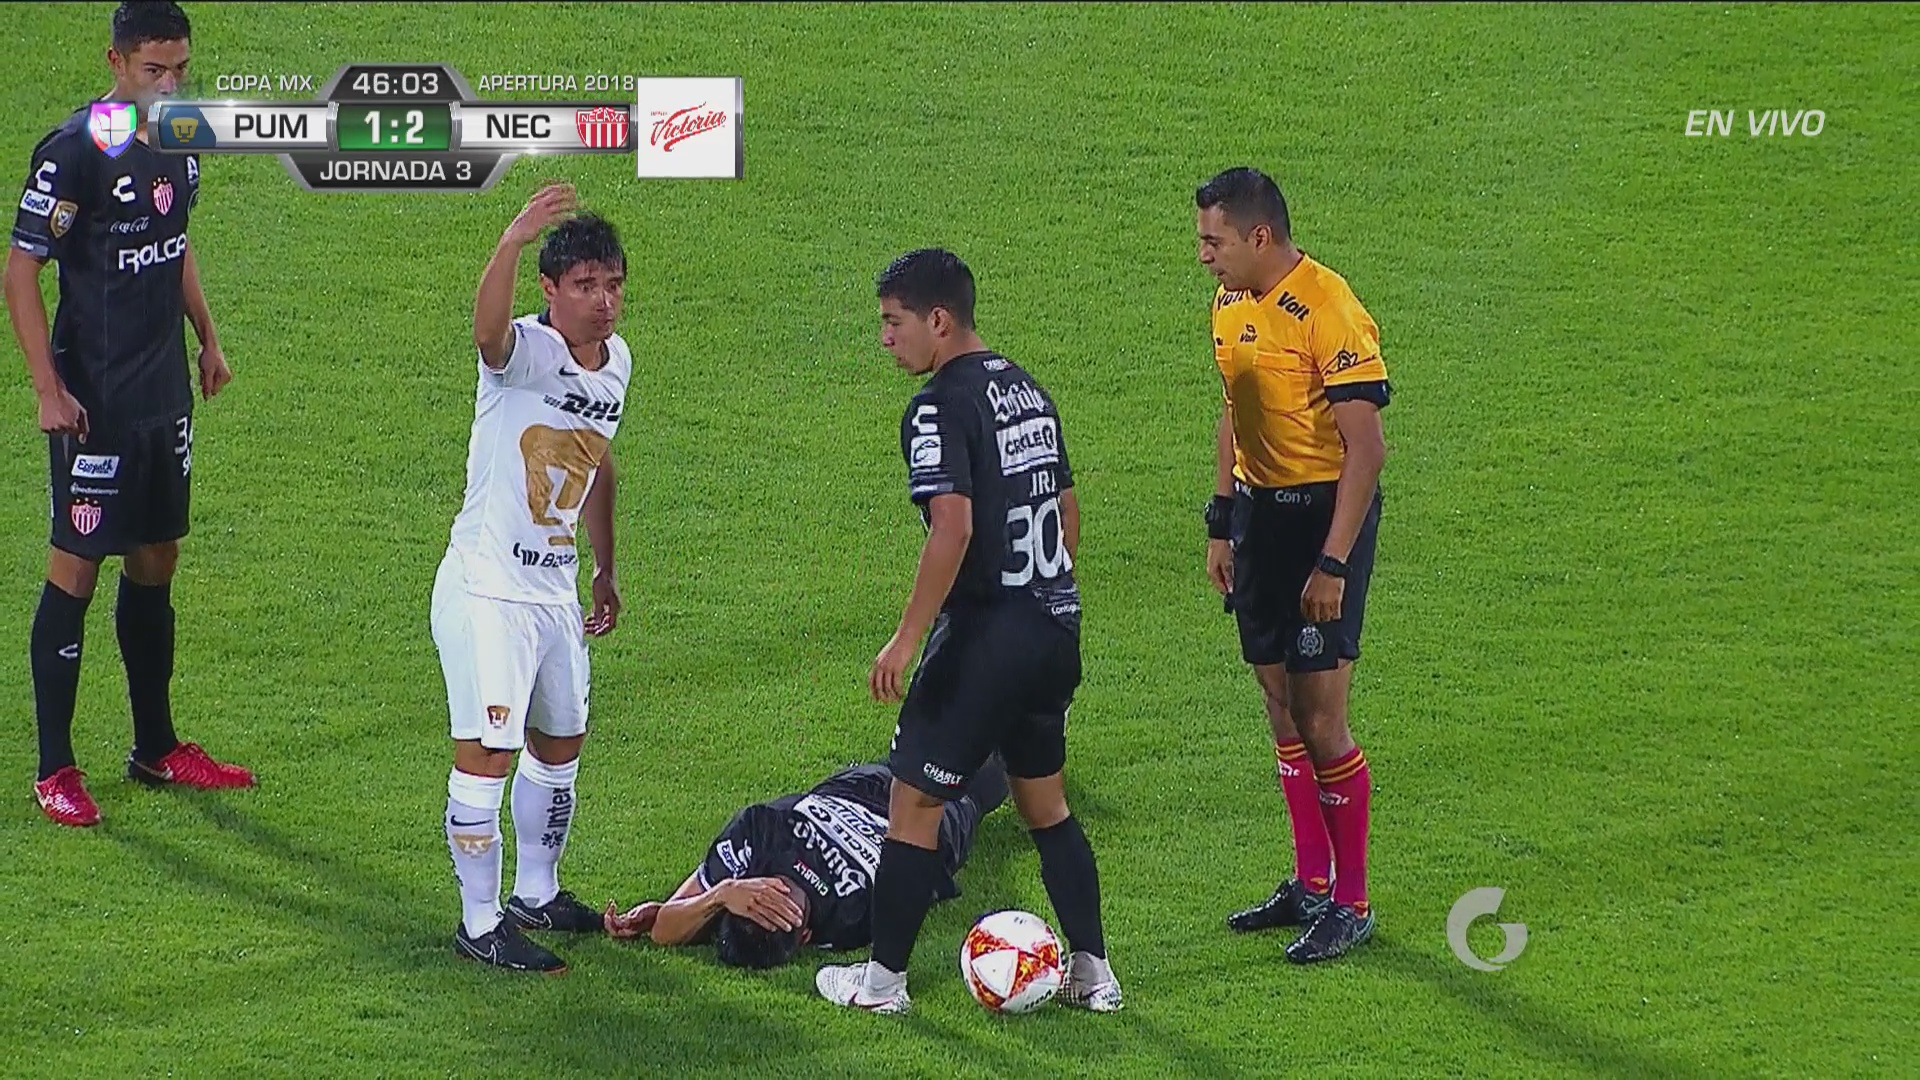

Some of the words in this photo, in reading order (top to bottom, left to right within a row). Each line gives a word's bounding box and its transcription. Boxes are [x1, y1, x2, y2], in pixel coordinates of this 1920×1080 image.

[1276, 290, 1311, 322] Voit
[1001, 496, 1073, 587] 30
[923, 762, 963, 785] CHARLY
[793, 860, 830, 897] CHARLY
